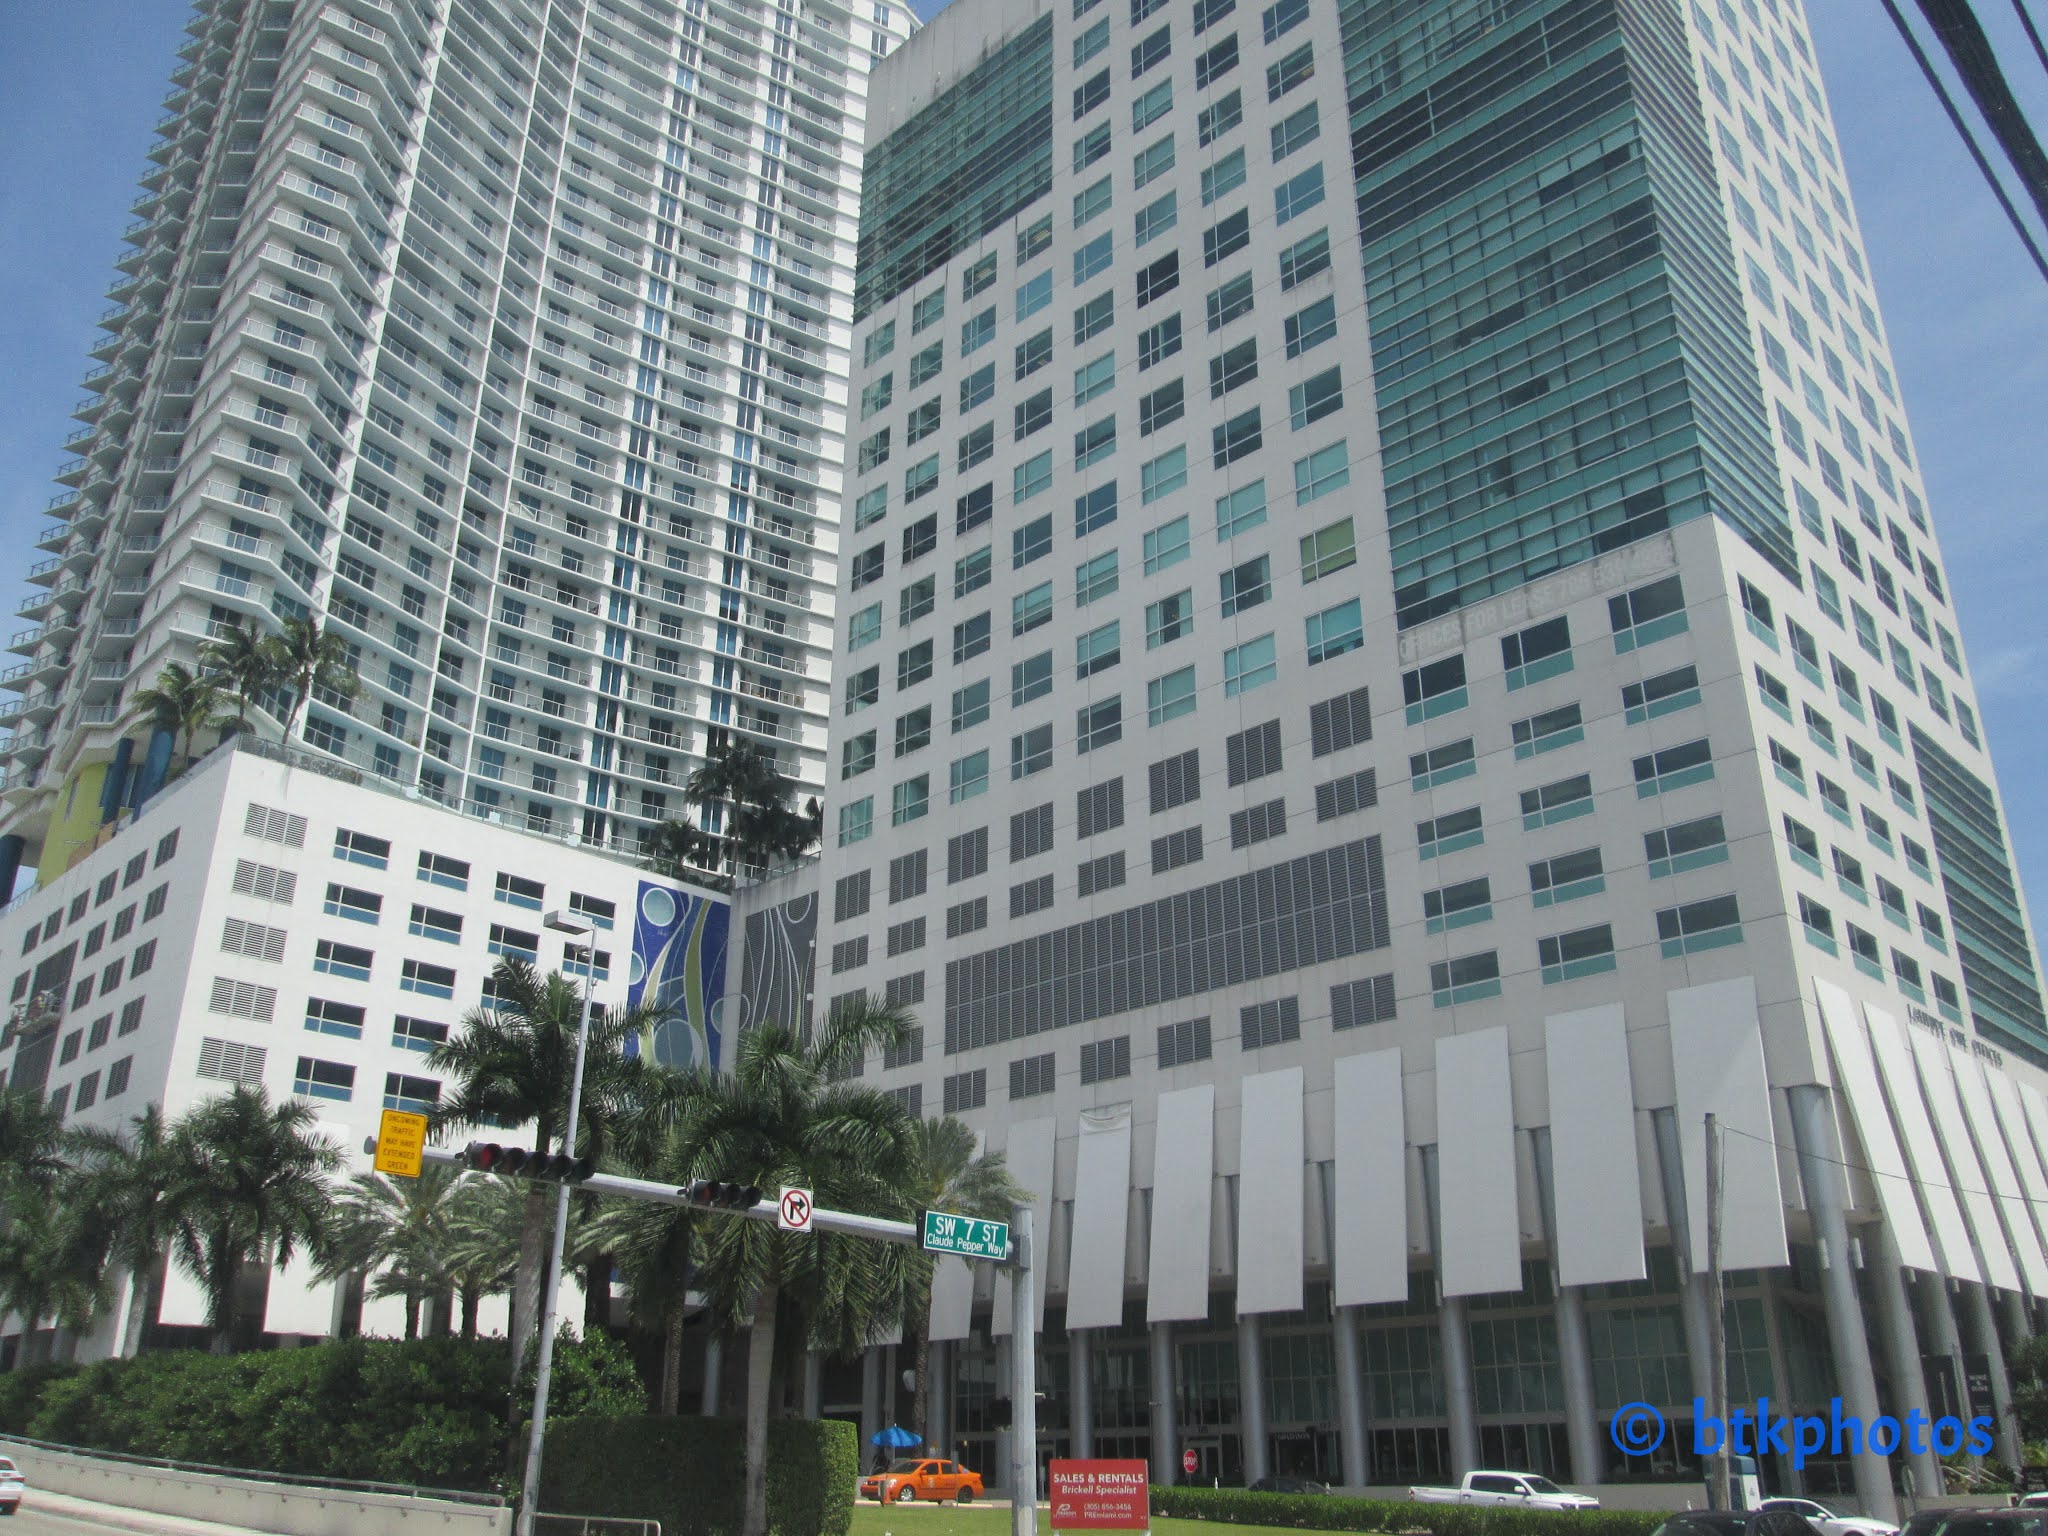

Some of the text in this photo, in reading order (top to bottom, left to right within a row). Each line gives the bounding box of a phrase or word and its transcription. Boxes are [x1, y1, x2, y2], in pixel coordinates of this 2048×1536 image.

[1465, 604, 1500, 635] FOR
[391, 1126, 415, 1136] TRAFFIC
[386, 1137, 416, 1149] MAY HAVE
[383, 1148, 415, 1160] EXTENDED
[387, 1161, 408, 1170] GREEN
[935, 1216, 999, 1243] SW 7 ST
[927, 1233, 1004, 1257] Claude Pepper Way
[1184, 1456, 1198, 1465] STOP
[1053, 1473, 1144, 1483] SALES & RENTALS
[1061, 1485, 1137, 1496] Brickell Specialist
[1083, 1503, 1100, 1511] (305)
[1084, 1511, 1132, 1519] PREmiami.com
